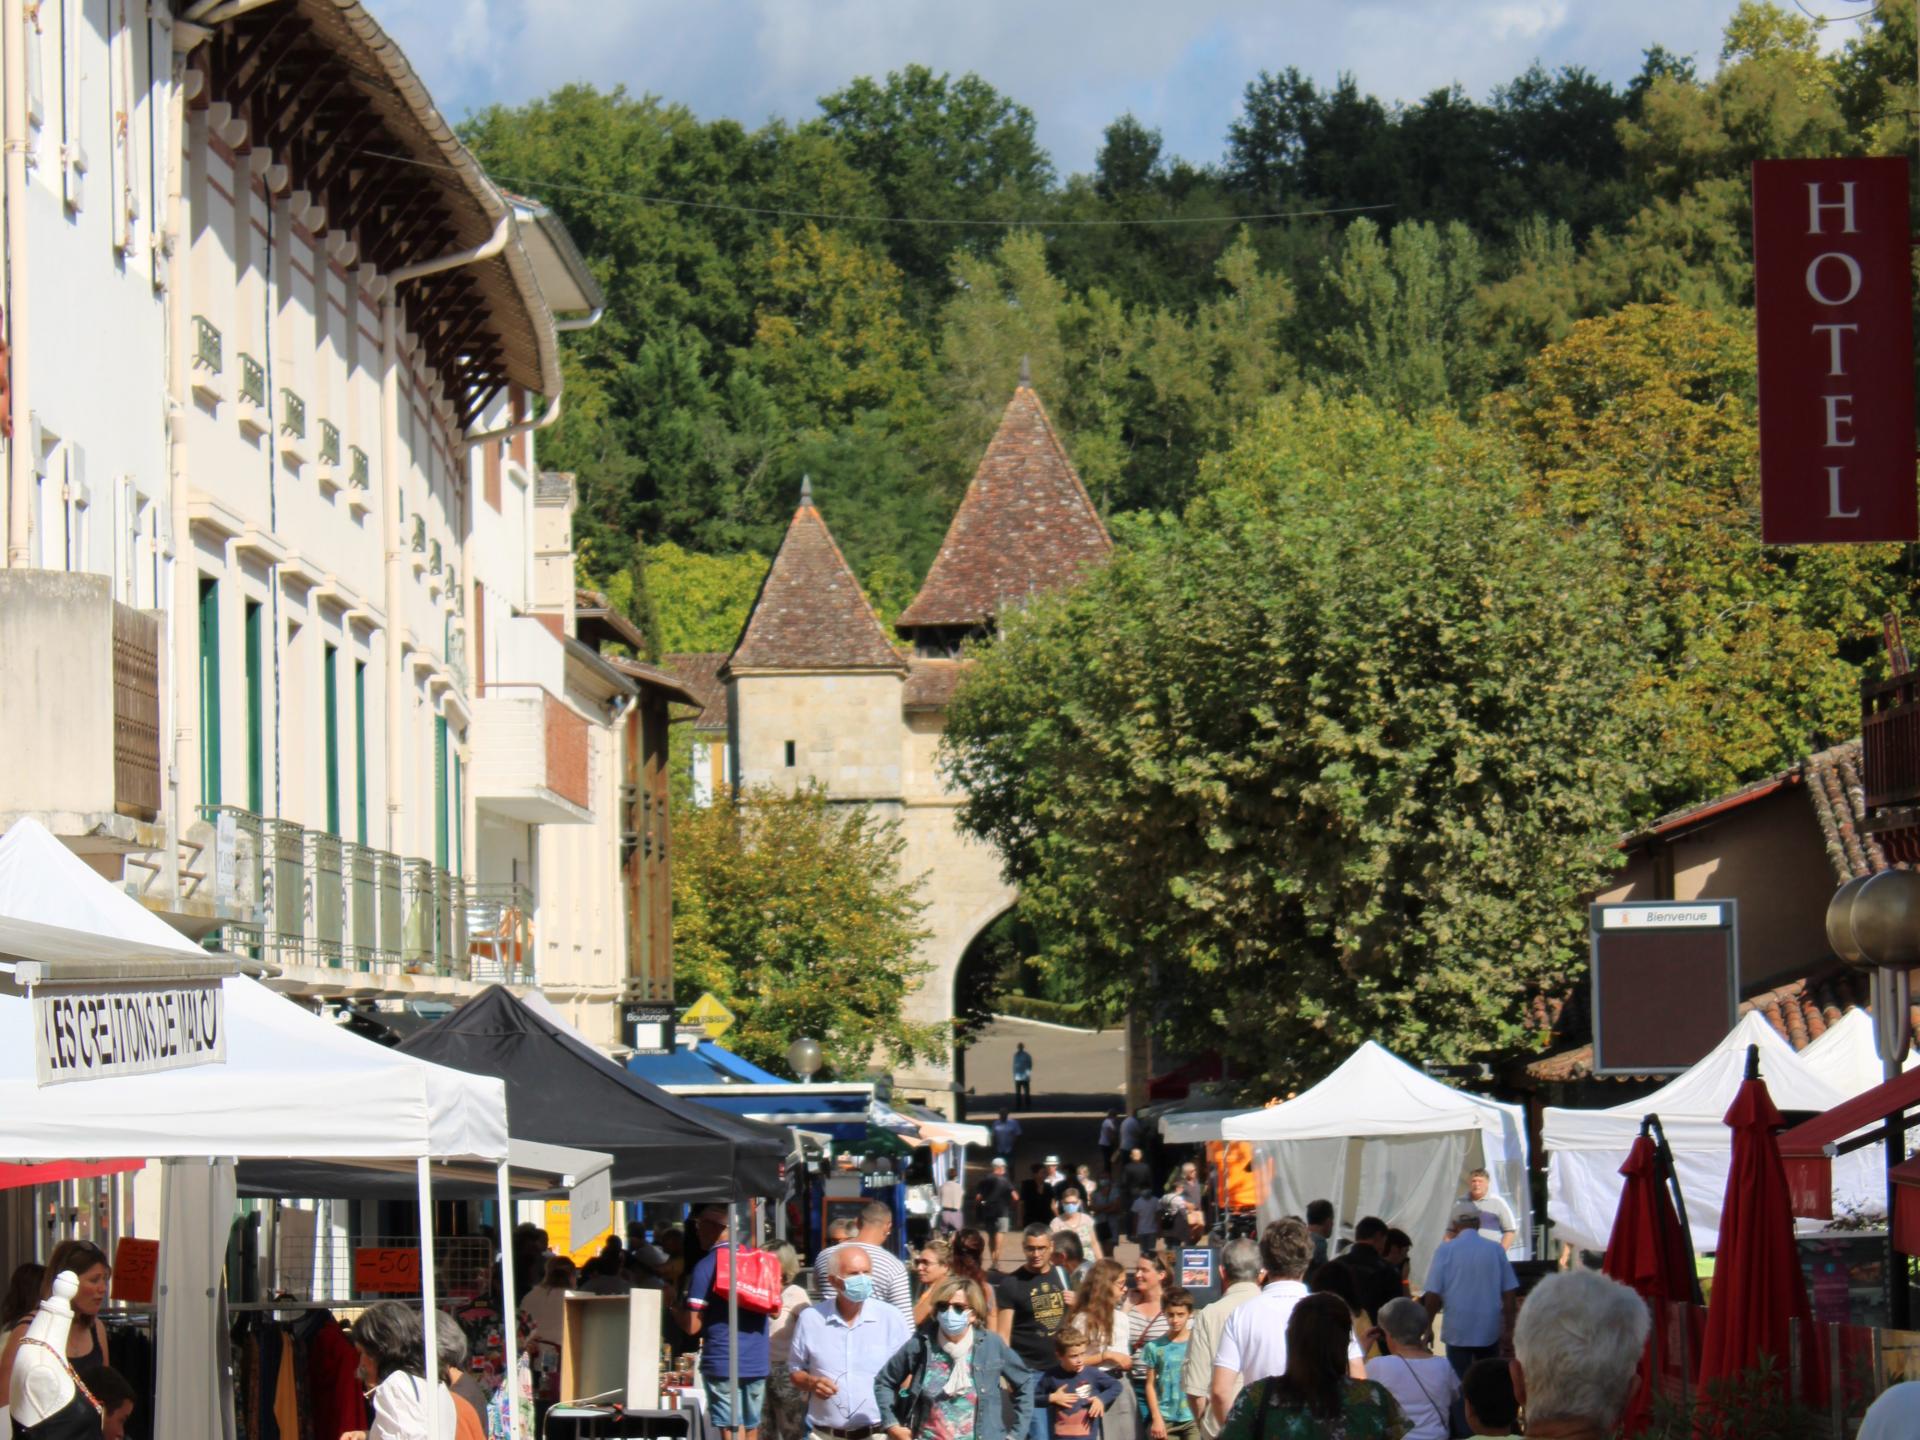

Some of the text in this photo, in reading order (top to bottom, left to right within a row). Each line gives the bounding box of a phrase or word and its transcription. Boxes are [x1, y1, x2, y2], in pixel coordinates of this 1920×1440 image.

[1804, 180, 1862, 519] HOTEL
[1646, 911, 1708, 923] Bienvenue
[626, 1013, 671, 1023] Boulanger
[687, 1014, 732, 1025] PRESSE
[156, 994, 178, 1058] DE
